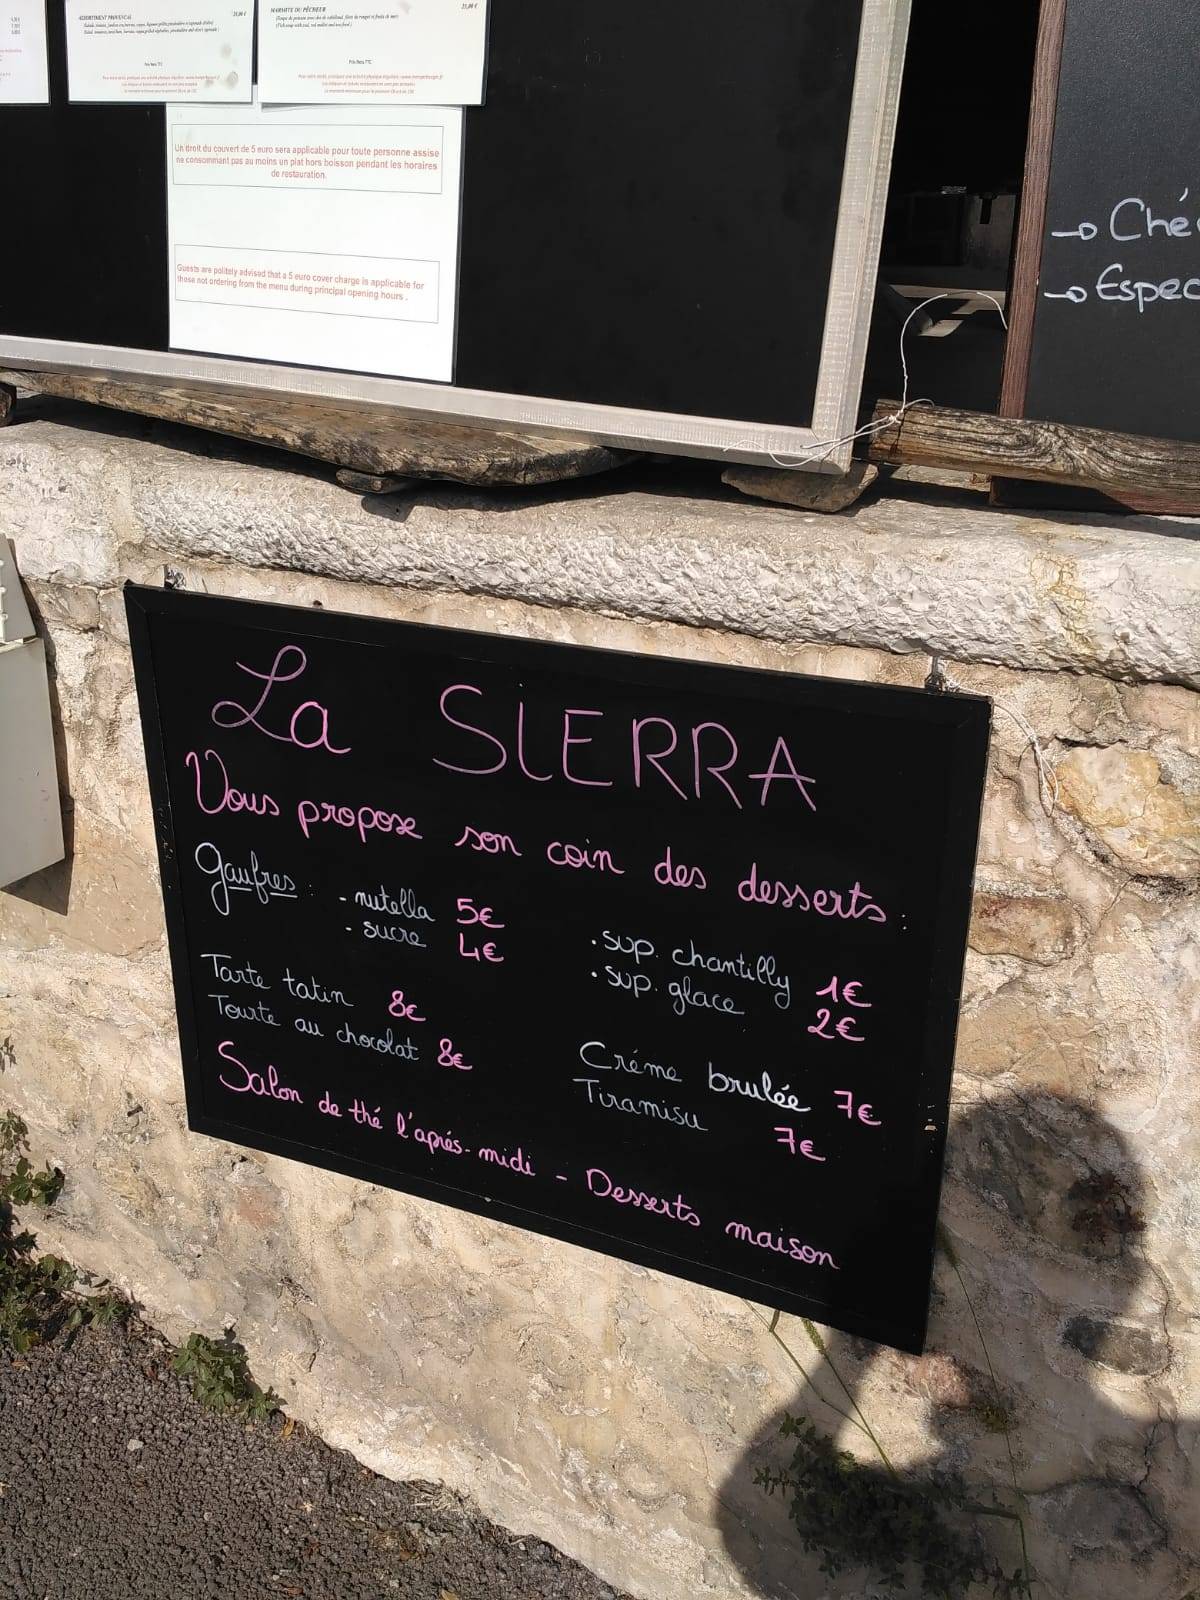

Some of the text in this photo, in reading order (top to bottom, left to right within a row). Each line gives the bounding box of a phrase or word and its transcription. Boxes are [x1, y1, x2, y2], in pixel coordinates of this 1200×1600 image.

[174, 144, 440, 160] Un droit du couvert de 5 euro sera applicable pour toute personne assise
[185, 156, 230, 165] consommant
[231, 158, 243, 167] pas
[255, 158, 277, 166] moins
[290, 159, 304, 168] plat
[305, 158, 322, 167] hors
[324, 158, 354, 168] boisson
[356, 160, 388, 170] pendant
[390, 160, 401, 169] les
[404, 161, 438, 170] horaires
[271, 170, 280, 178] de
[176, 263, 200, 273] Guests
[213, 266, 238, 277] politely
[239, 268, 266, 278] advised
[267, 270, 281, 279] that
[288, 271, 293, 280] 5
[294, 273, 311, 281] euro
[312, 274, 333, 283] cover
[334, 274, 361, 286] charge
[361, 276, 369, 285] is
[370, 277, 411, 289] applicable
[412, 280, 425, 290] for
[177, 275, 196, 284] those
[196, 276, 208, 285] not
[209, 277, 237, 288] ordering
[238, 278, 255, 288] from
[256, 280, 267, 289] the
[268, 282, 289, 291] menu
[289, 283, 313, 294] during
[314, 285, 346, 297] principal
[347, 288, 379, 300] opening
[381, 290, 404, 300] hours
[207, 645, 352, 758] La
[185, 749, 280, 816] Vous
[297, 800, 423, 843] propose
[454, 825, 523, 857] son
[546, 838, 625, 875] coin
[654, 846, 707, 890] des
[737, 862, 887, 923] desserts
[354, 884, 436, 922] nutella
[456, 897, 505, 929] 5€
[362, 920, 505, 963] sucre 4€
[200, 953, 427, 1022] Tarte tatin 8€
[668, 939, 791, 1011] chantilly
[815, 975, 873, 1008] 1€
[668, 973, 749, 1016] glace
[807, 1004, 869, 1042] 2€
[294, 1018, 325, 1037] au
[336, 1019, 423, 1061] chocolat
[437, 1037, 473, 1071] 8€
[572, 1078, 826, 1162] Tiramisu 7€
[708, 1062, 812, 1113] brulée
[833, 1090, 882, 1126] 7€
[217, 1040, 304, 1104] Salon
[318, 1090, 343, 1118] de
[347, 1098, 384, 1130] thé
[585, 1168, 701, 1227] Desserts
[724, 1221, 839, 1270] maison
